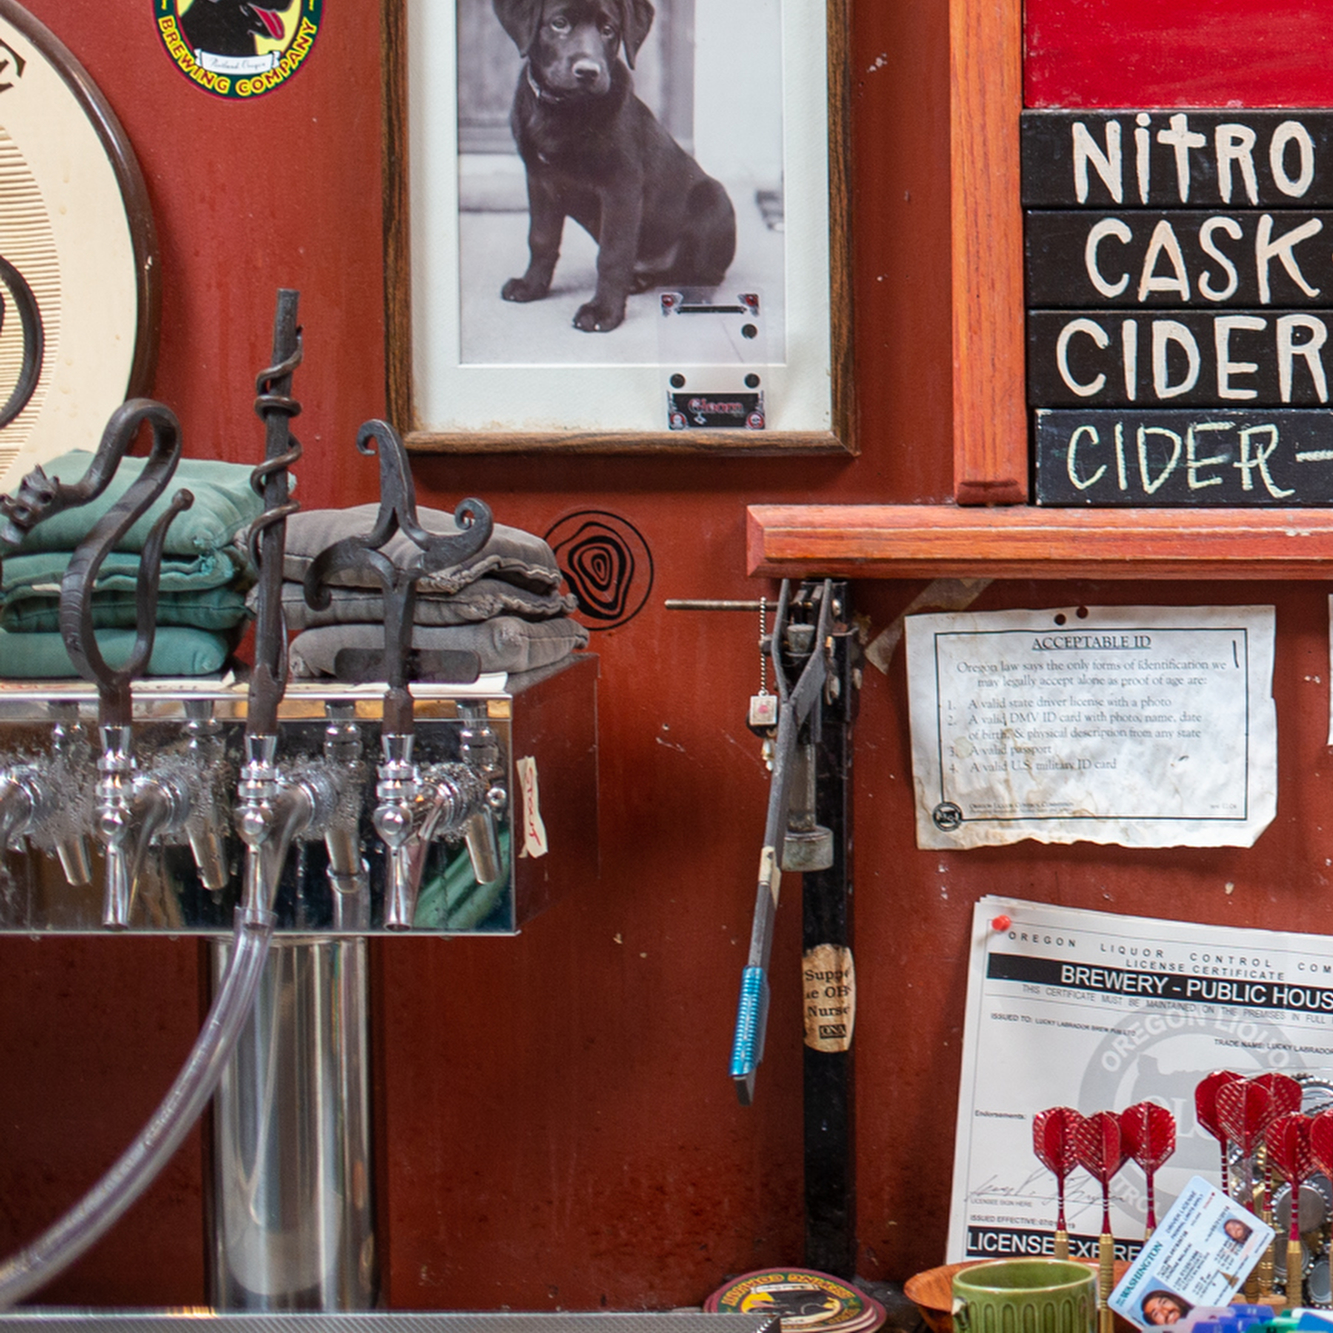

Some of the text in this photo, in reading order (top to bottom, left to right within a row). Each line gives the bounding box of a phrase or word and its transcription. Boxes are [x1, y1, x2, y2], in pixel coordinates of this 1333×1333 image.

[158, 13, 317, 97] BREWING COMPANY
[1084, 214, 1323, 305] CASK
[1056, 313, 1329, 404] CIDER
[1066, 420, 1297, 499] CIDER
[1032, 636, 1152, 650] ACCEPTABLE ID
[1008, 930, 1165, 959] OREGON LIQUOR
[1060, 964, 1170, 996] BREWERY
[1185, 977, 1267, 1005] PUBLIC
